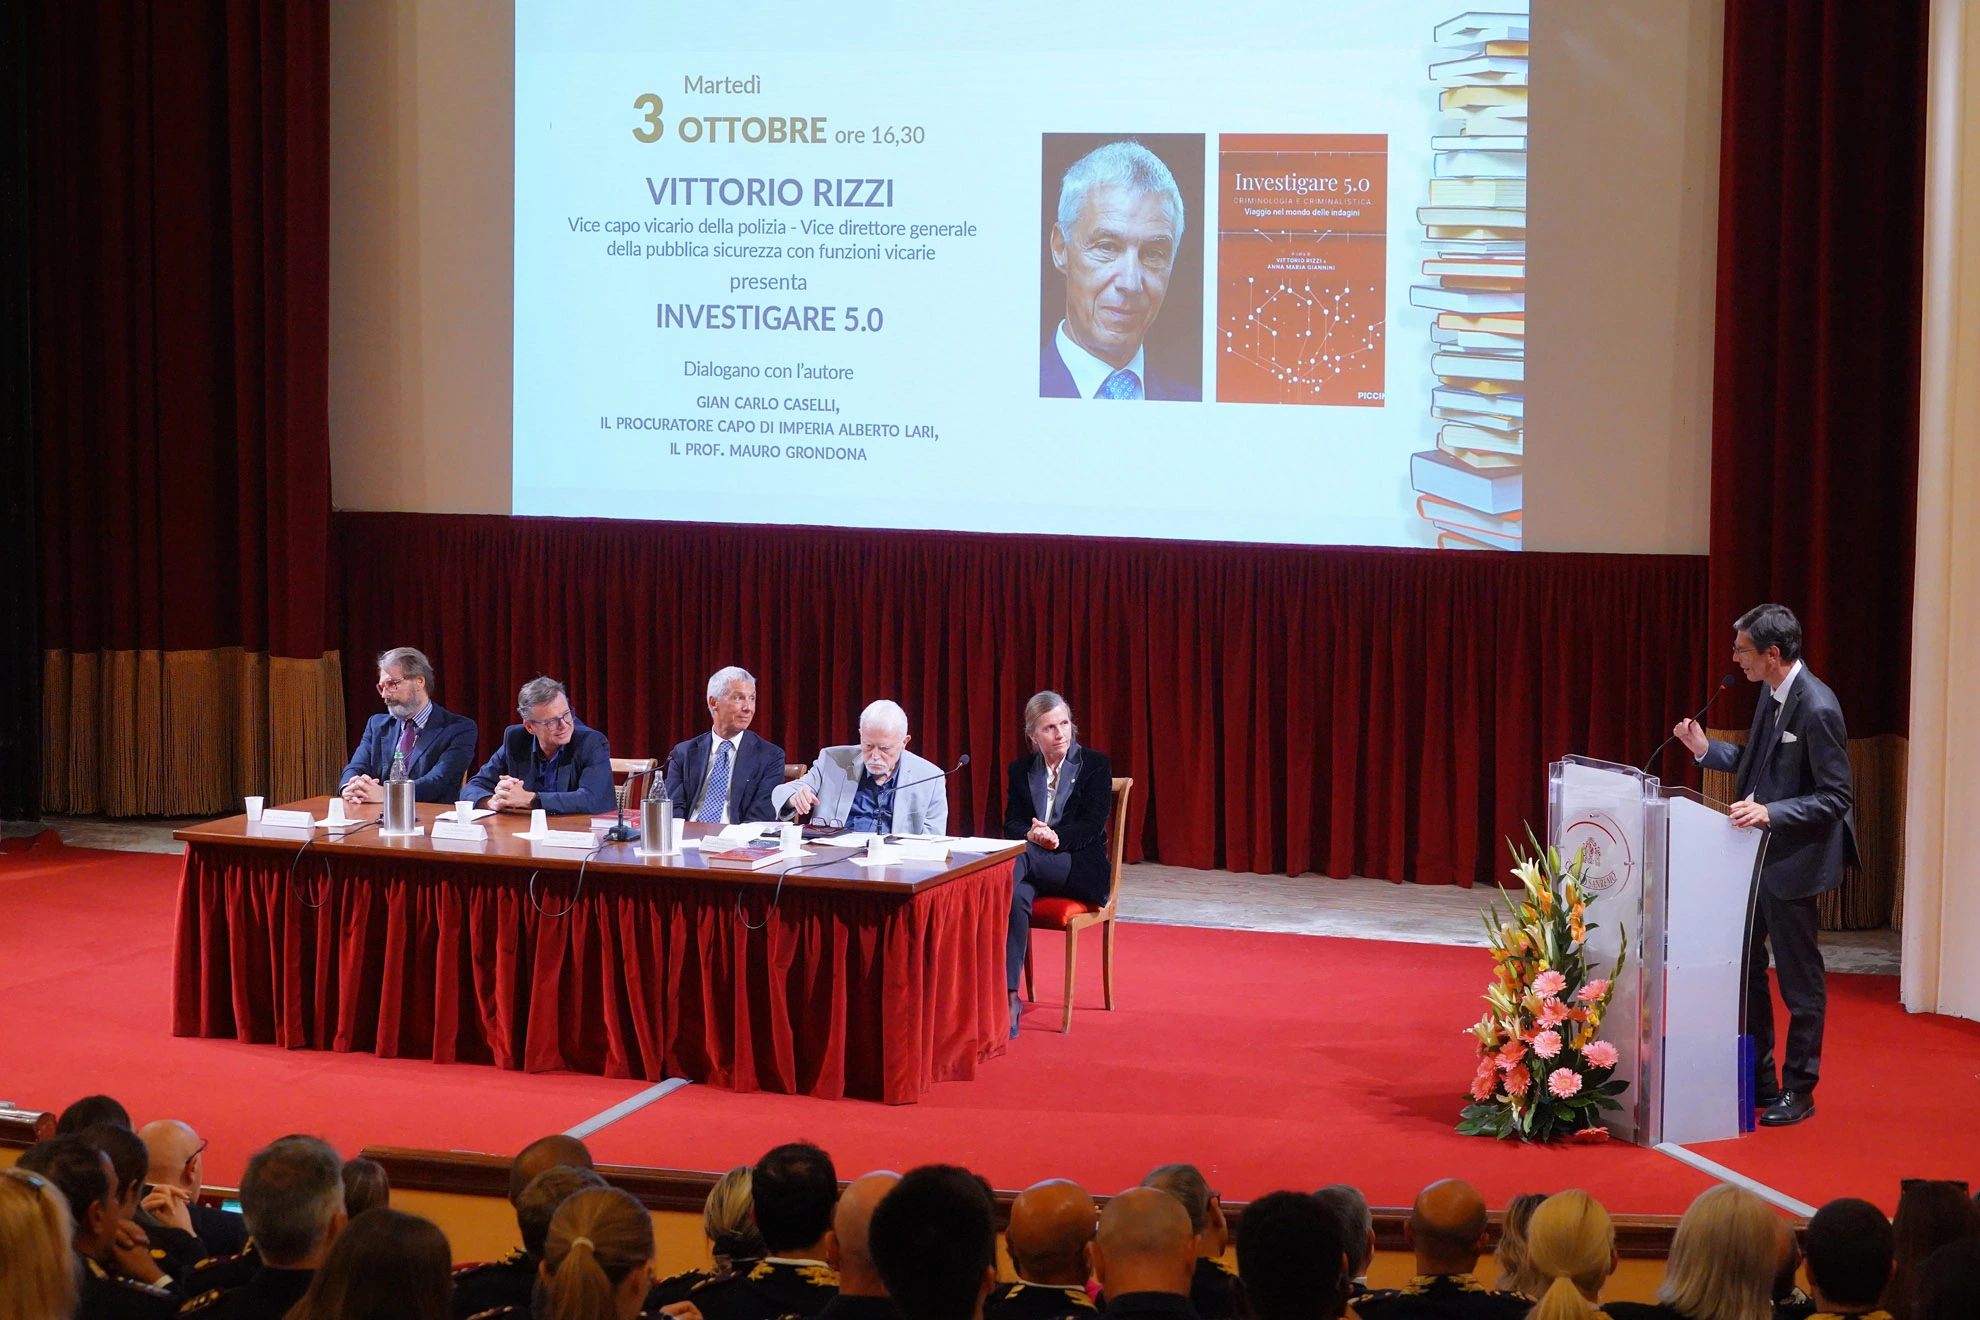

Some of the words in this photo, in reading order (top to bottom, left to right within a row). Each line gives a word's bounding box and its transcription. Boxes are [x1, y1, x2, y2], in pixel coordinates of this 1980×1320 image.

[684, 75, 761, 94] Martedì
[632, 93, 665, 144] 3
[679, 116, 828, 144] OTTOBRE
[835, 128, 865, 144] ore
[871, 125, 925, 147] 16,30
[645, 177, 803, 206] VITTORIO
[814, 178, 893, 207] RIZZI
[1235, 173, 1338, 195] Investigare
[1344, 178, 1370, 195] 5.0
[1233, 197, 1293, 205] CRIMINOLOGIA
[1303, 198, 1372, 206] CRIMINALISTICA
[1244, 208, 1271, 217] Viaggio
[1273, 208, 1284, 216] nel
[1286, 208, 1310, 216] mondo
[1312, 208, 1330, 216] delle
[1331, 209, 1360, 218] indagini
[568, 216, 600, 232] Vice
[604, 219, 640, 236] capo
[644, 217, 694, 233] vicario
[698, 217, 733, 234] della
[738, 218, 786, 237] polizia
[800, 219, 834, 235] Vice
[839, 219, 906, 236] direttore
[910, 220, 977, 239] generale
[607, 240, 641, 256] della
[646, 241, 709, 260] pubblica
[713, 242, 782, 259] sicurezza
[787, 247, 814, 259] con
[819, 243, 880, 260] funzioni
[884, 244, 935, 260] vicarie
[730, 274, 807, 293] presenta
[657, 303, 836, 332] INVESTIGARE
[844, 307, 883, 332] 5.0
[684, 361, 760, 380] Dialogano
[764, 367, 792, 378] con
[697, 395, 729, 409] GIAN
[735, 396, 779, 410] CARLO
[784, 397, 840, 415] CASELLI,
[601, 416, 612, 429] IL
[616, 417, 713, 432] PROCURATORE
[717, 420, 755, 433] CAPO
[760, 421, 774, 434] DI
[779, 421, 835, 436] IMPERIA
[838, 423, 900, 437] ALBERTO
[905, 425, 939, 442] LARI,
[670, 442, 681, 455] IL
[686, 442, 725, 456] PROF.
[730, 444, 781, 458] MAURO
[786, 445, 867, 461] GRONDONA
